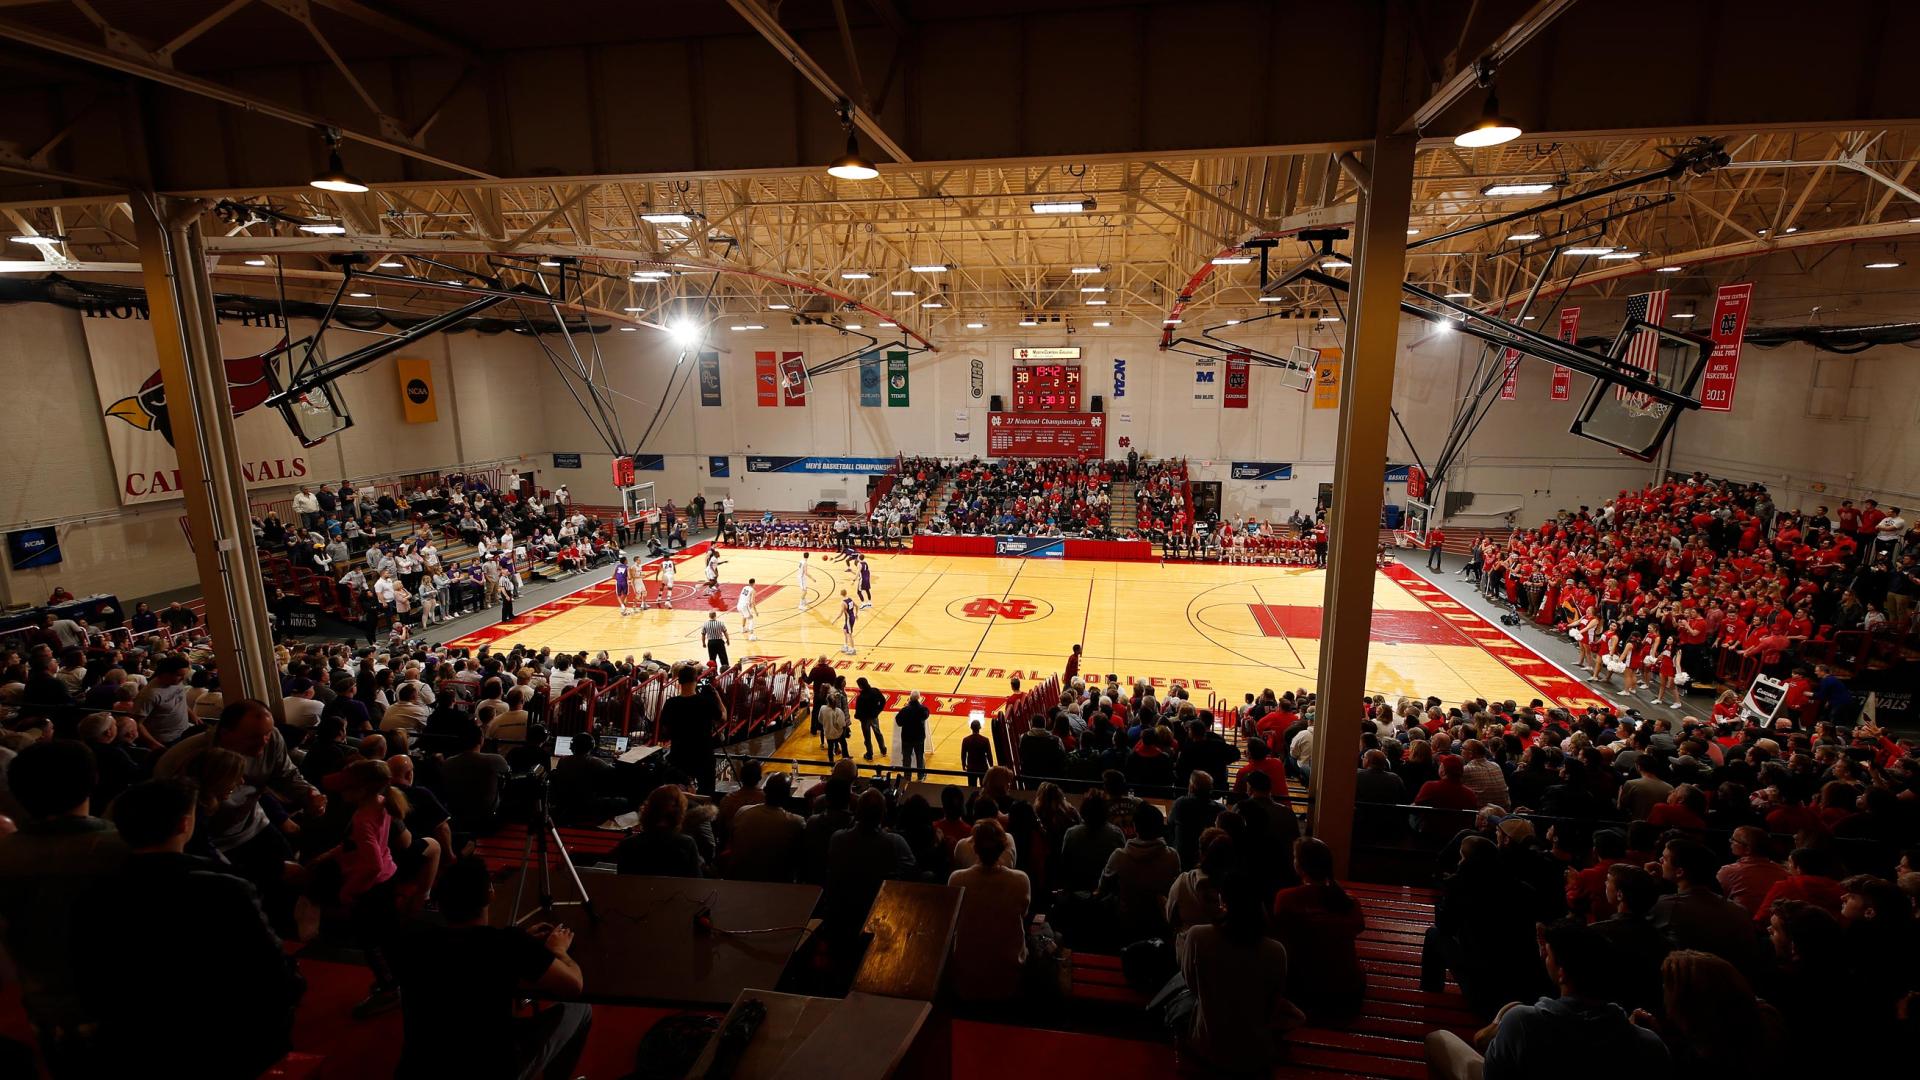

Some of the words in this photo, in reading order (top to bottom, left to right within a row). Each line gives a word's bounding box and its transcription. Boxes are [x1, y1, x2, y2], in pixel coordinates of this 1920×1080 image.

[84, 304, 150, 320] HOM
[1036, 366, 1061, 377] 19:42
[1196, 371, 1214, 382] M
[1017, 372, 1029, 383] 38
[1053, 379, 1059, 387] 2
[1067, 372, 1079, 383] 34
[1114, 358, 1126, 397] NCAA
[1706, 390, 1726, 401] 2013
[1041, 418, 1086, 426] Championships
[822, 463, 854, 471] BASKETBALL
[126, 457, 306, 496] CANALS
[24, 539, 45, 548] NCAA
[1397, 579, 1605, 710] CARDINALS
[798, 657, 895, 672] NRTH
[904, 663, 1046, 681] CENTRAL
[1063, 673, 1213, 690] OLEGE
